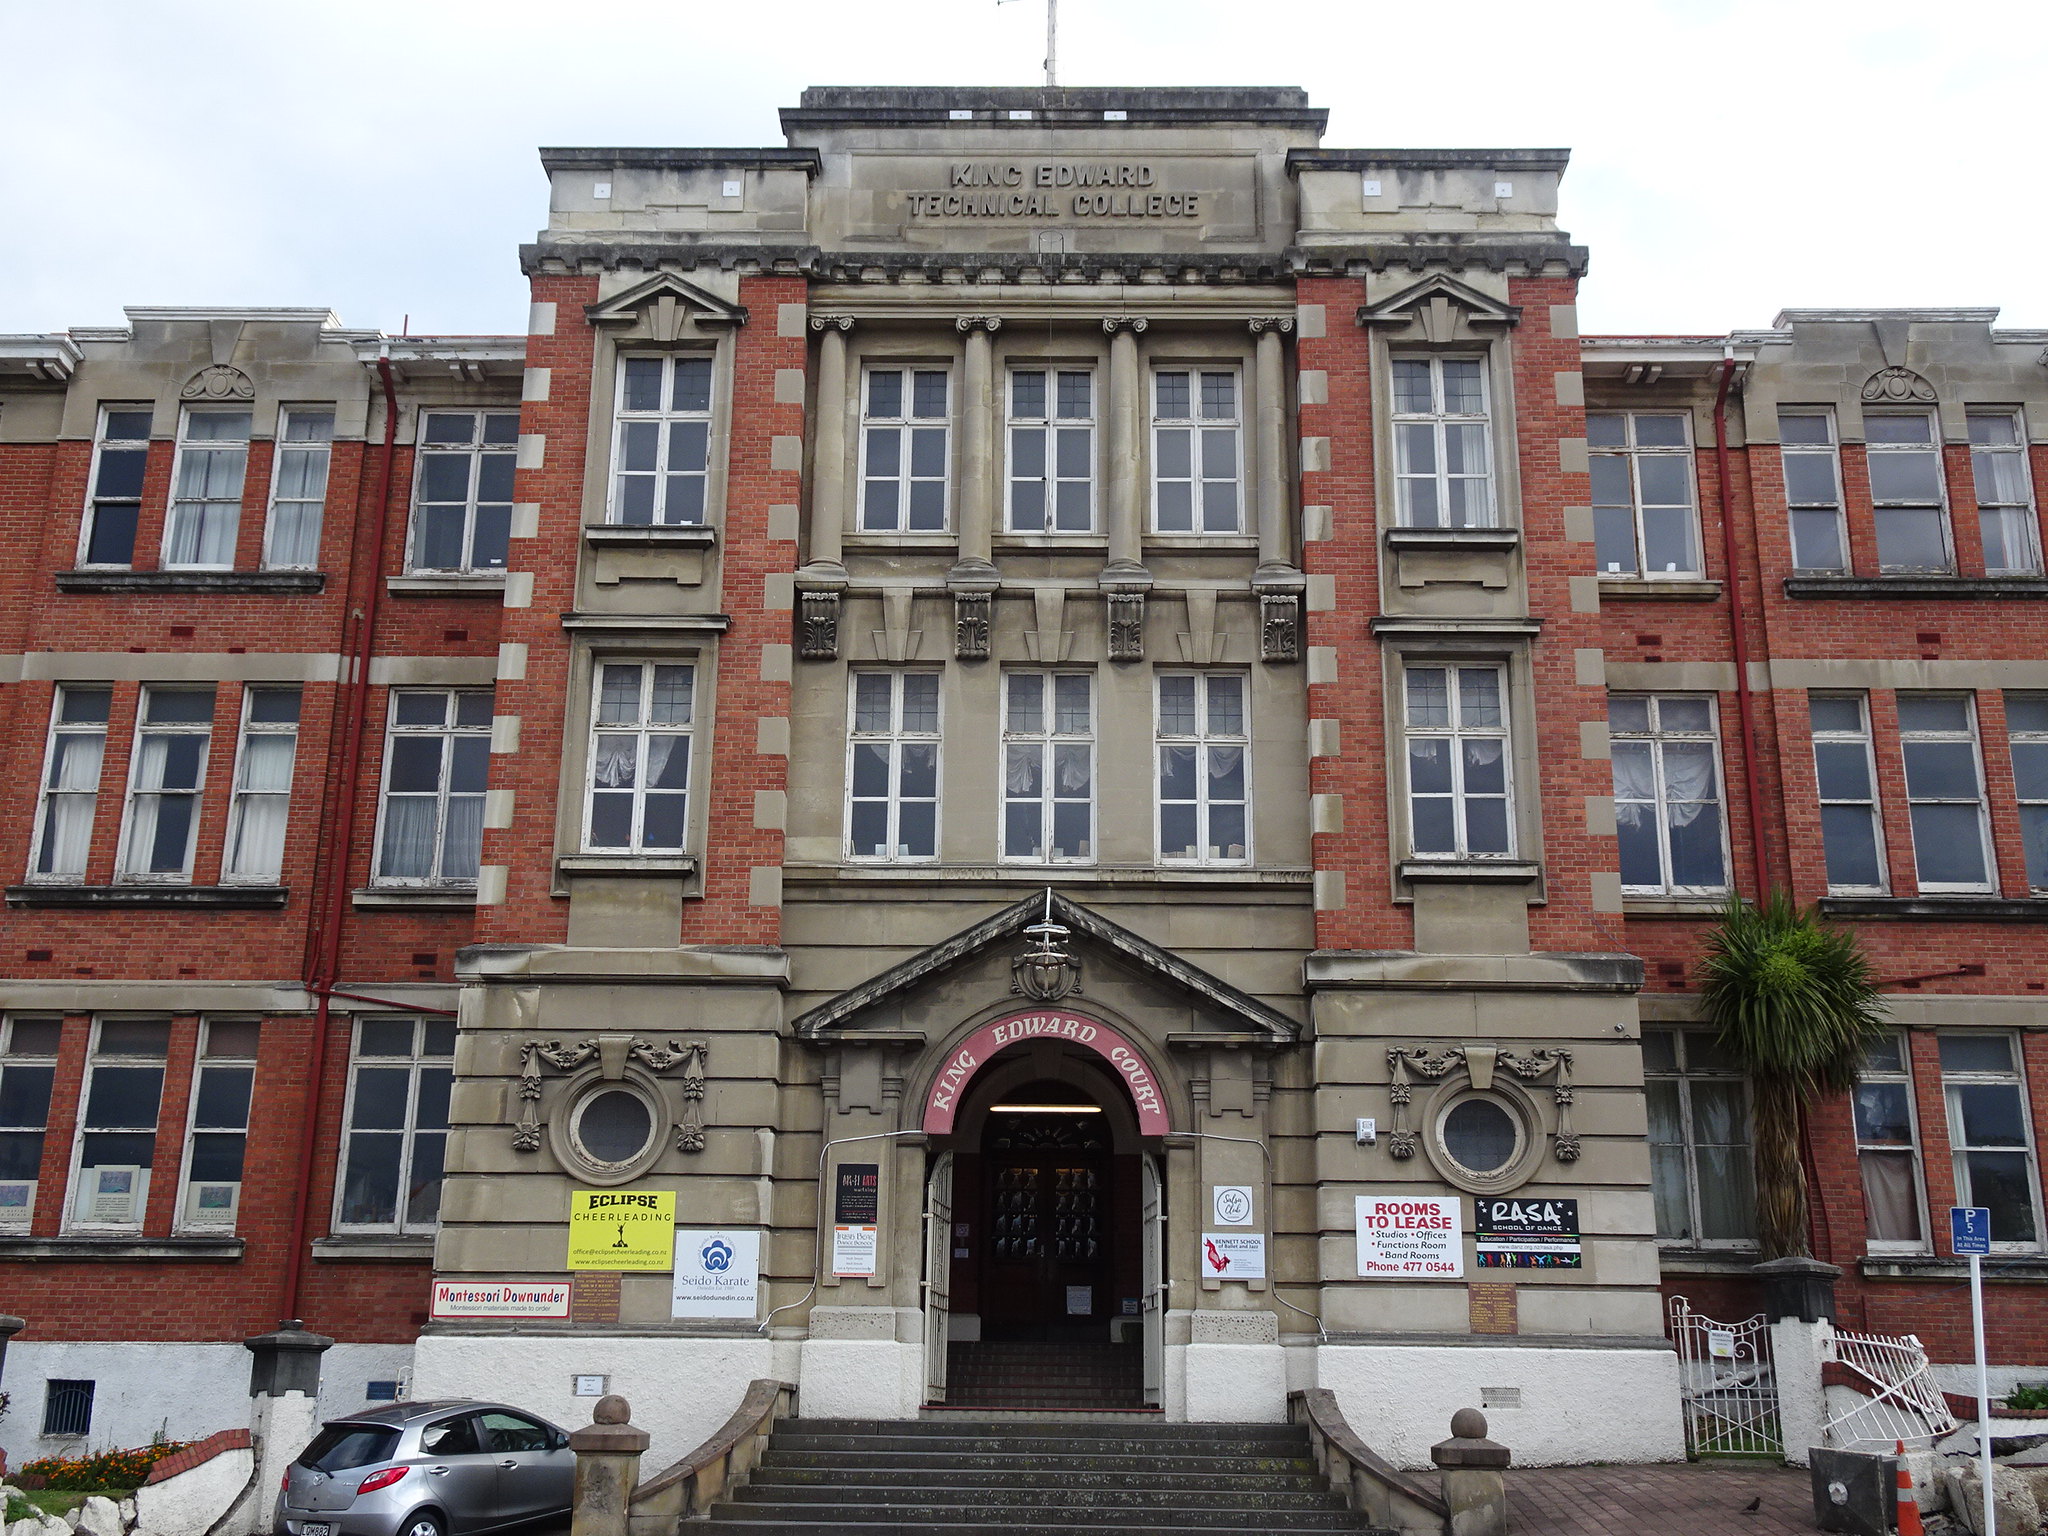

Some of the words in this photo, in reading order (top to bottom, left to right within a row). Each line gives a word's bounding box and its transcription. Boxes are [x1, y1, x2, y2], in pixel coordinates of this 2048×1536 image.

[951, 164, 1022, 187] KING
[1036, 164, 1157, 187] EDWARD
[908, 193, 1060, 217] TECHNICAL
[1073, 193, 1199, 217] COLLEGE
[933, 1049, 977, 1112] KING
[992, 1016, 1097, 1045] EDWARD
[1111, 1047, 1161, 1115] COURT
[589, 1195, 658, 1210] ECLIPSE
[1375, 1203, 1441, 1216] ROOMS
[1491, 1201, 1562, 1225] RASA
[1965, 1209, 1976, 1222] P
[574, 1213, 671, 1221] CHEERLEADING
[1365, 1216, 1389, 1229] TO
[1395, 1216, 1452, 1229] LEASE
[1967, 1222, 1974, 1234] 5
[1375, 1230, 1408, 1239] Studios
[1416, 1230, 1447, 1240] Offices
[1377, 1240, 1419, 1249] Functions
[1421, 1241, 1447, 1249] Room
[1385, 1251, 1408, 1259] Band
[1410, 1251, 1440, 1259] Rooms
[1366, 1261, 1400, 1271] Phone
[1403, 1262, 1422, 1272] 477
[1426, 1262, 1455, 1272] 0544
[682, 1275, 712, 1286] Seido
[715, 1275, 750, 1286] Karate
[439, 1287, 500, 1302] Montessori
[503, 1287, 565, 1303] Downunder
